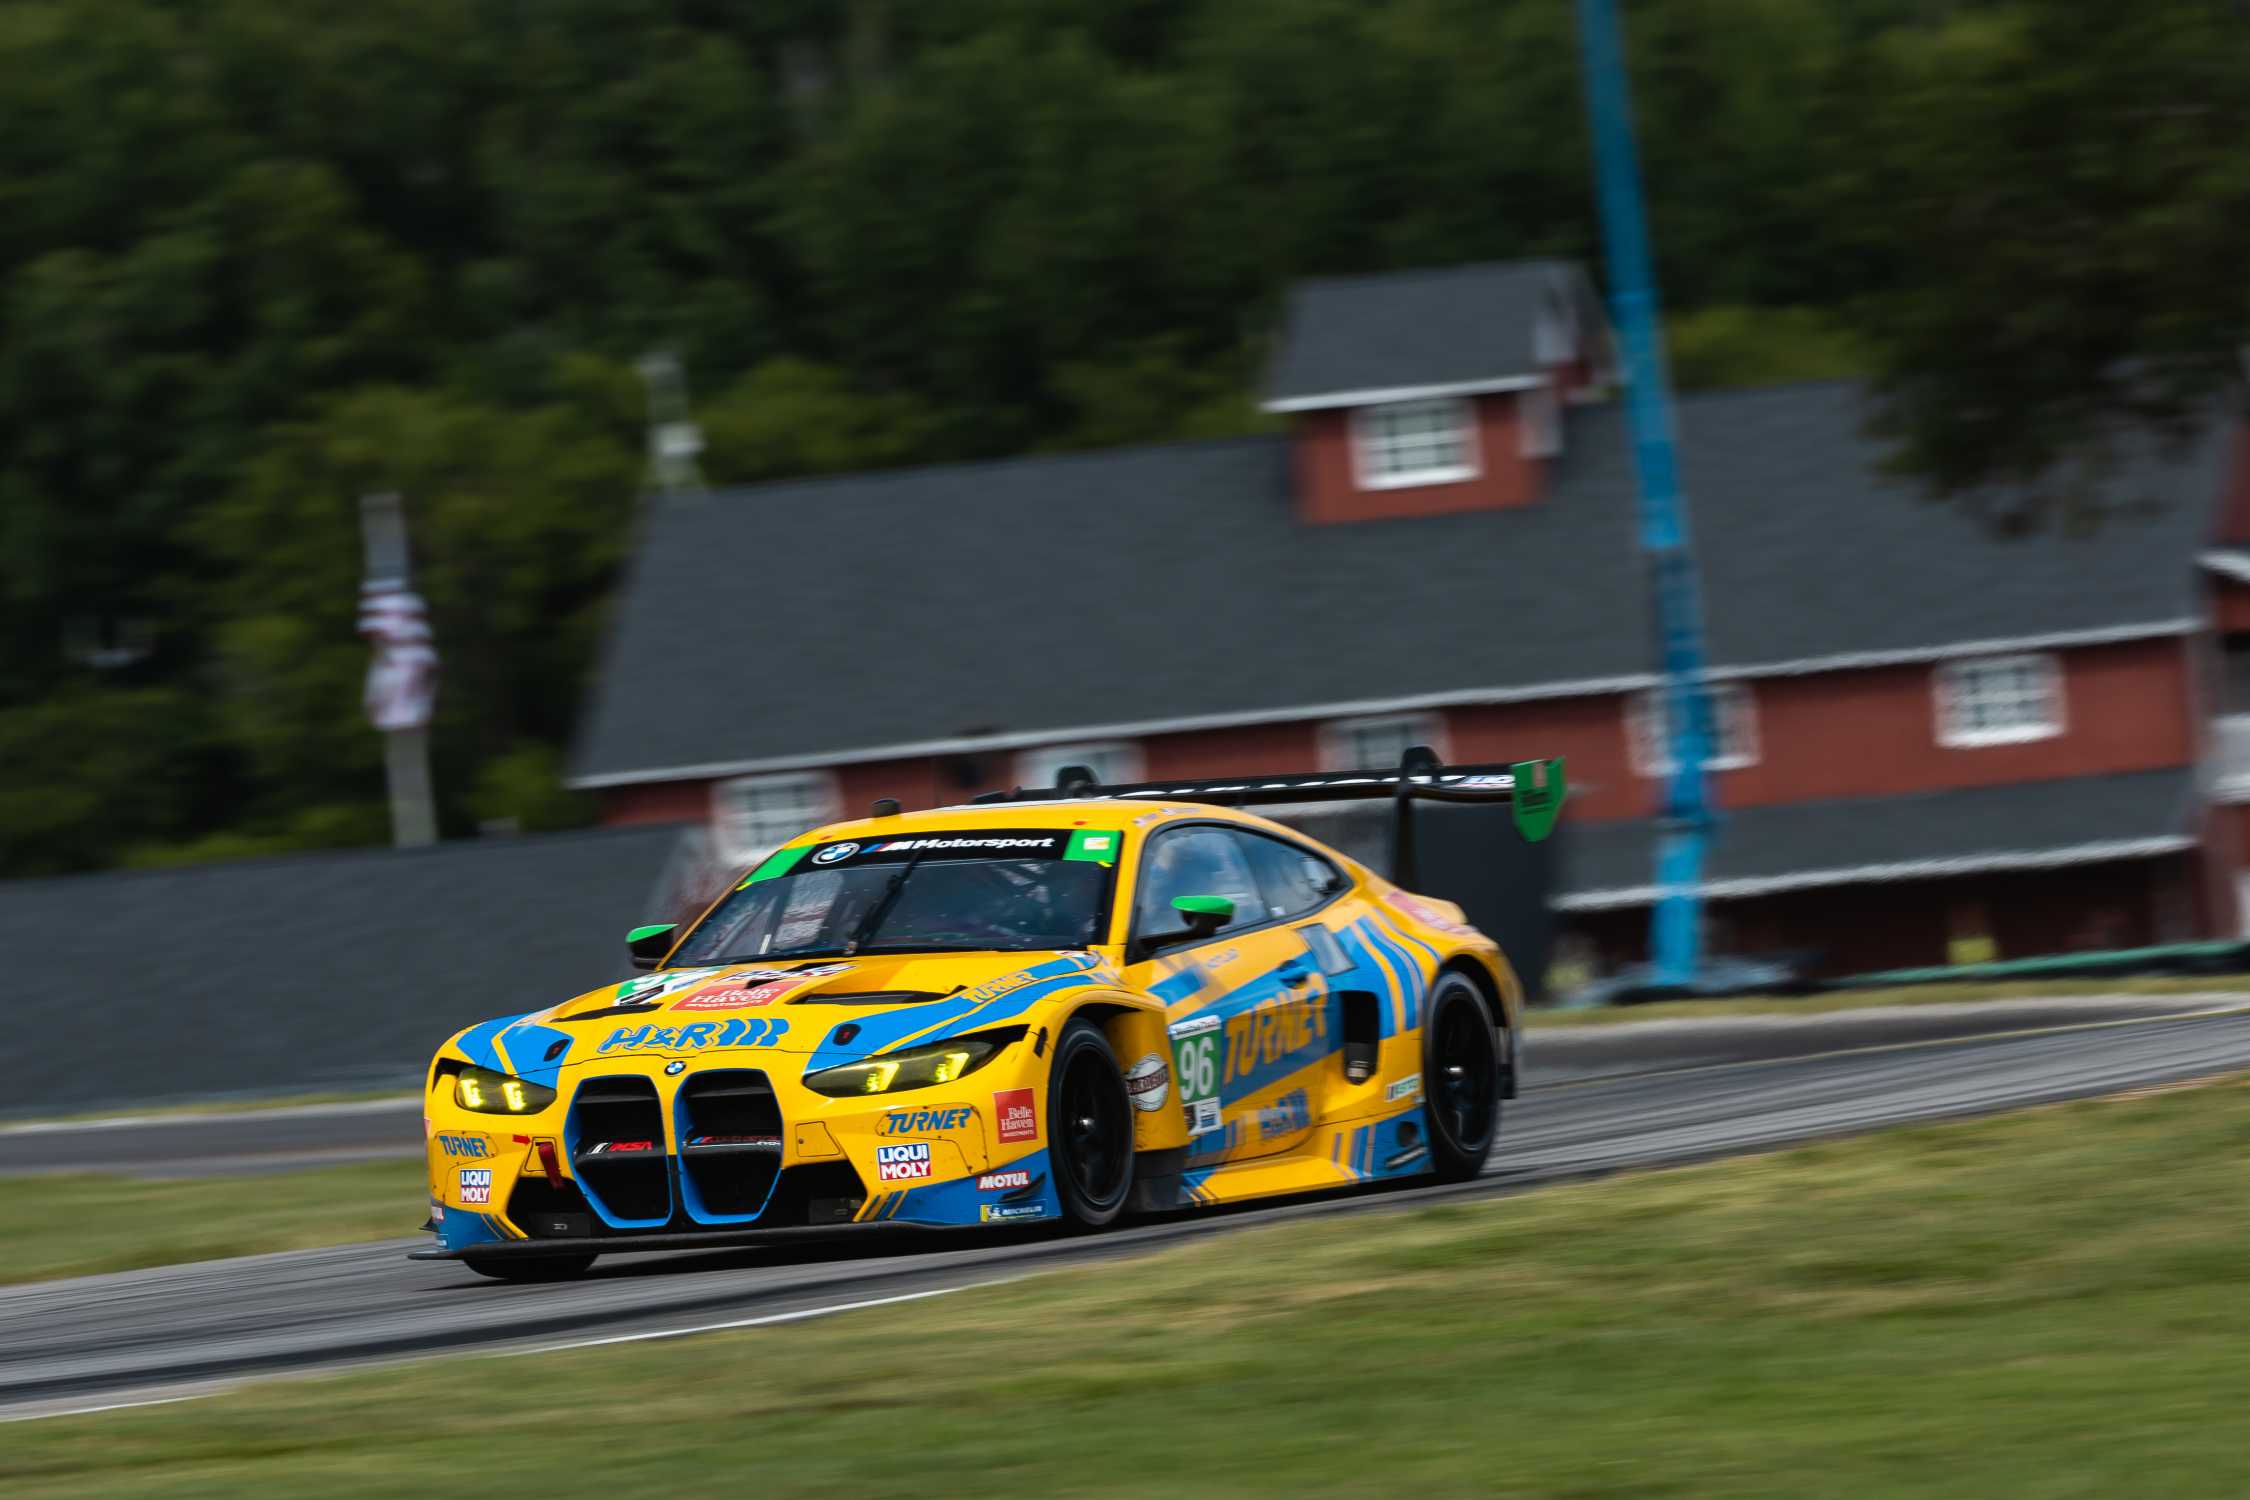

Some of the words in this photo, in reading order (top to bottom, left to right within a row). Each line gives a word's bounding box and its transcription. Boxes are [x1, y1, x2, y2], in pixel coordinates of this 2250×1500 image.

[911, 837, 1055, 849] Motorsport
[720, 987, 780, 997] Belle
[961, 971, 1039, 1004] TURNER
[689, 994, 773, 1005] Haven
[598, 1019, 722, 1054] H&R
[1223, 972, 1328, 1085] TURNER
[1179, 1036, 1215, 1101] 96
[887, 1108, 971, 1134] TURNER
[1007, 1106, 1033, 1119] Belle
[1000, 1118, 1034, 1131] Haven
[438, 1135, 489, 1157] TURNER
[879, 1144, 928, 1162] LIQUI
[461, 1171, 491, 1186] LIQUI
[880, 1161, 930, 1180] MOLY
[979, 1172, 1030, 1190] MOTUL
[461, 1187, 490, 1202] MOLY
